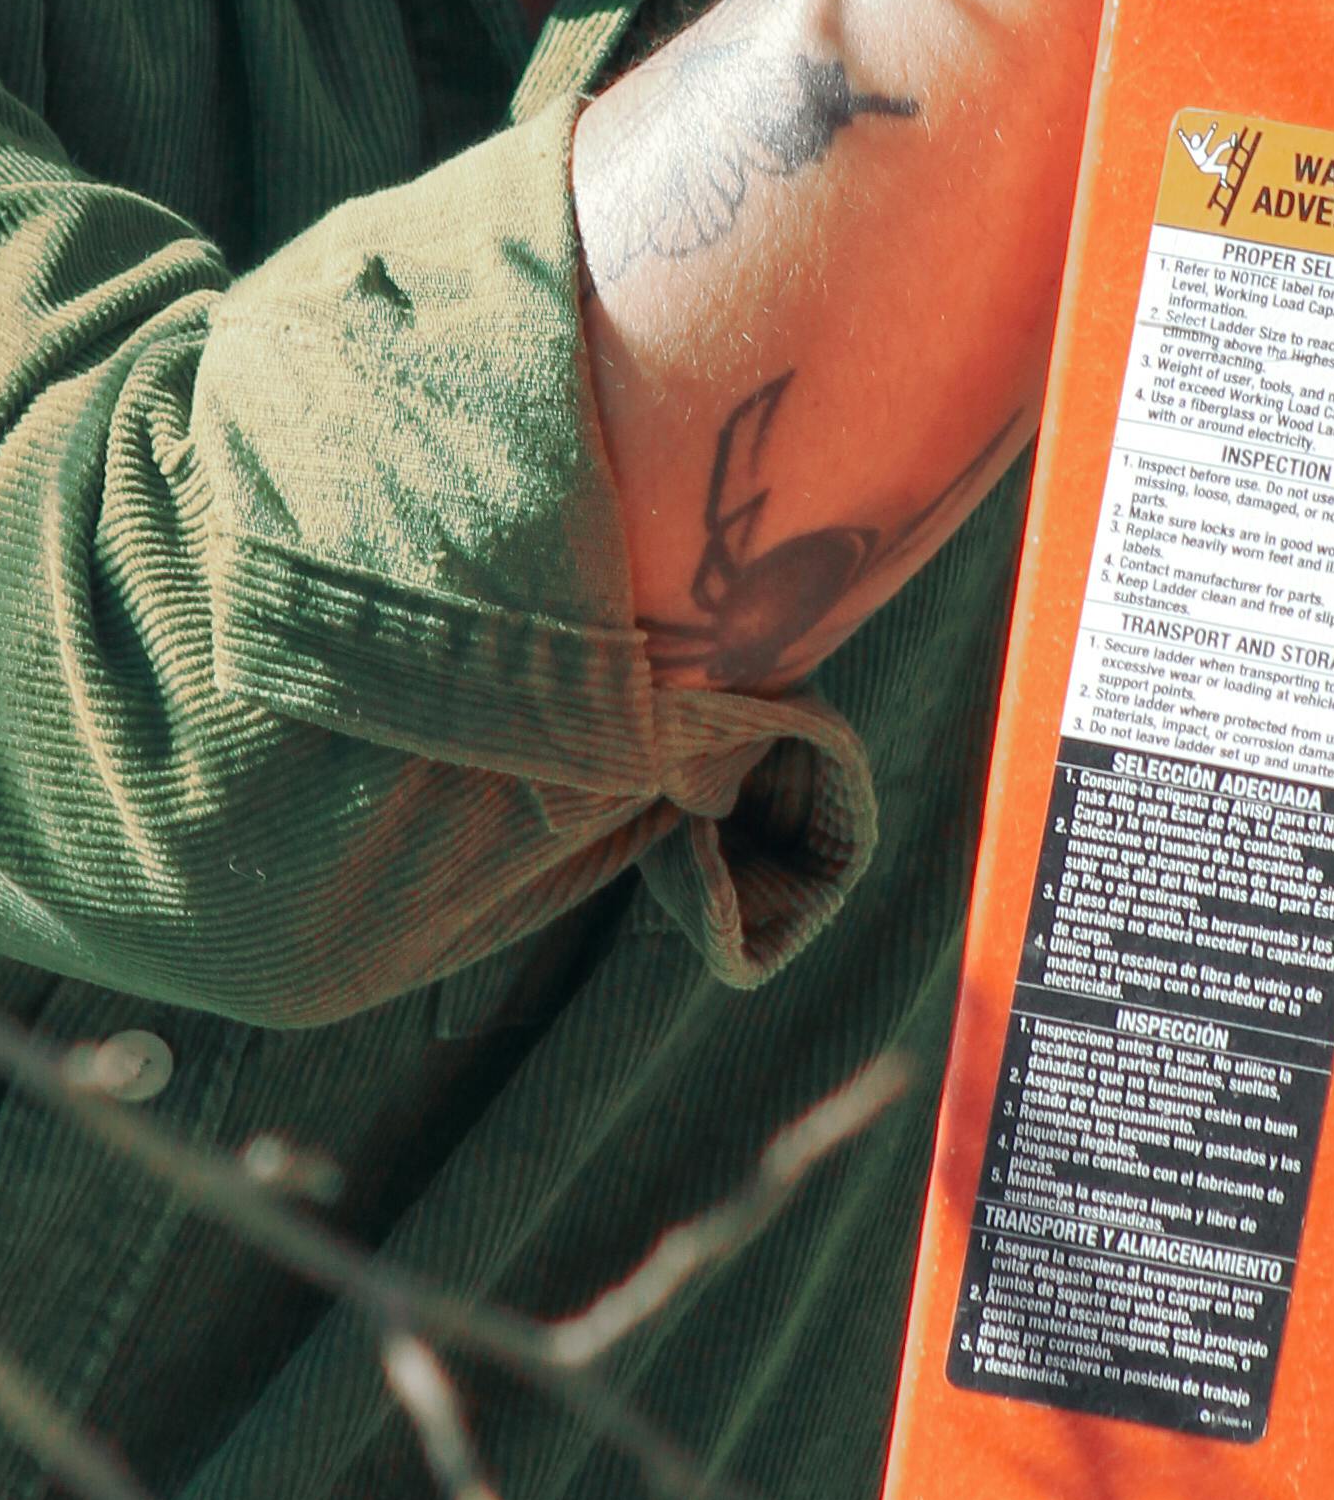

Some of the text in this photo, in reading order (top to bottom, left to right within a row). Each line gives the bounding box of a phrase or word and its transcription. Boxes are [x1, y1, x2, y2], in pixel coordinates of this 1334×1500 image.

[1174, 260, 1209, 277] Refer
[1213, 267, 1227, 281] to
[1229, 270, 1277, 290] NOTICE
[1281, 280, 1314, 296] label
[1222, 243, 1296, 271] PROPER
[1171, 277, 1209, 297] Level,
[1212, 284, 1269, 307] Working
[1271, 295, 1305, 311] Load
[1221, 445, 1332, 481] INSPECTION
[1118, 556, 1170, 576] Contact
[1172, 566, 1262, 594] manufacturer
[1264, 583, 1284, 598] for
[1287, 587, 1325, 608] parts.
[1119, 614, 1230, 650] TRANSPORT
[1235, 635, 1276, 658] AND
[1111, 749, 1324, 811] SELECCIÓN ADECUADA
[1042, 885, 1334, 953] 3. El peso del usuario, las herramientas y los
[1115, 1004, 1230, 1050] INSPECCIÓN
[982, 1205, 1283, 1283] TRANSPORTE Y ALMACENAMIENTO
